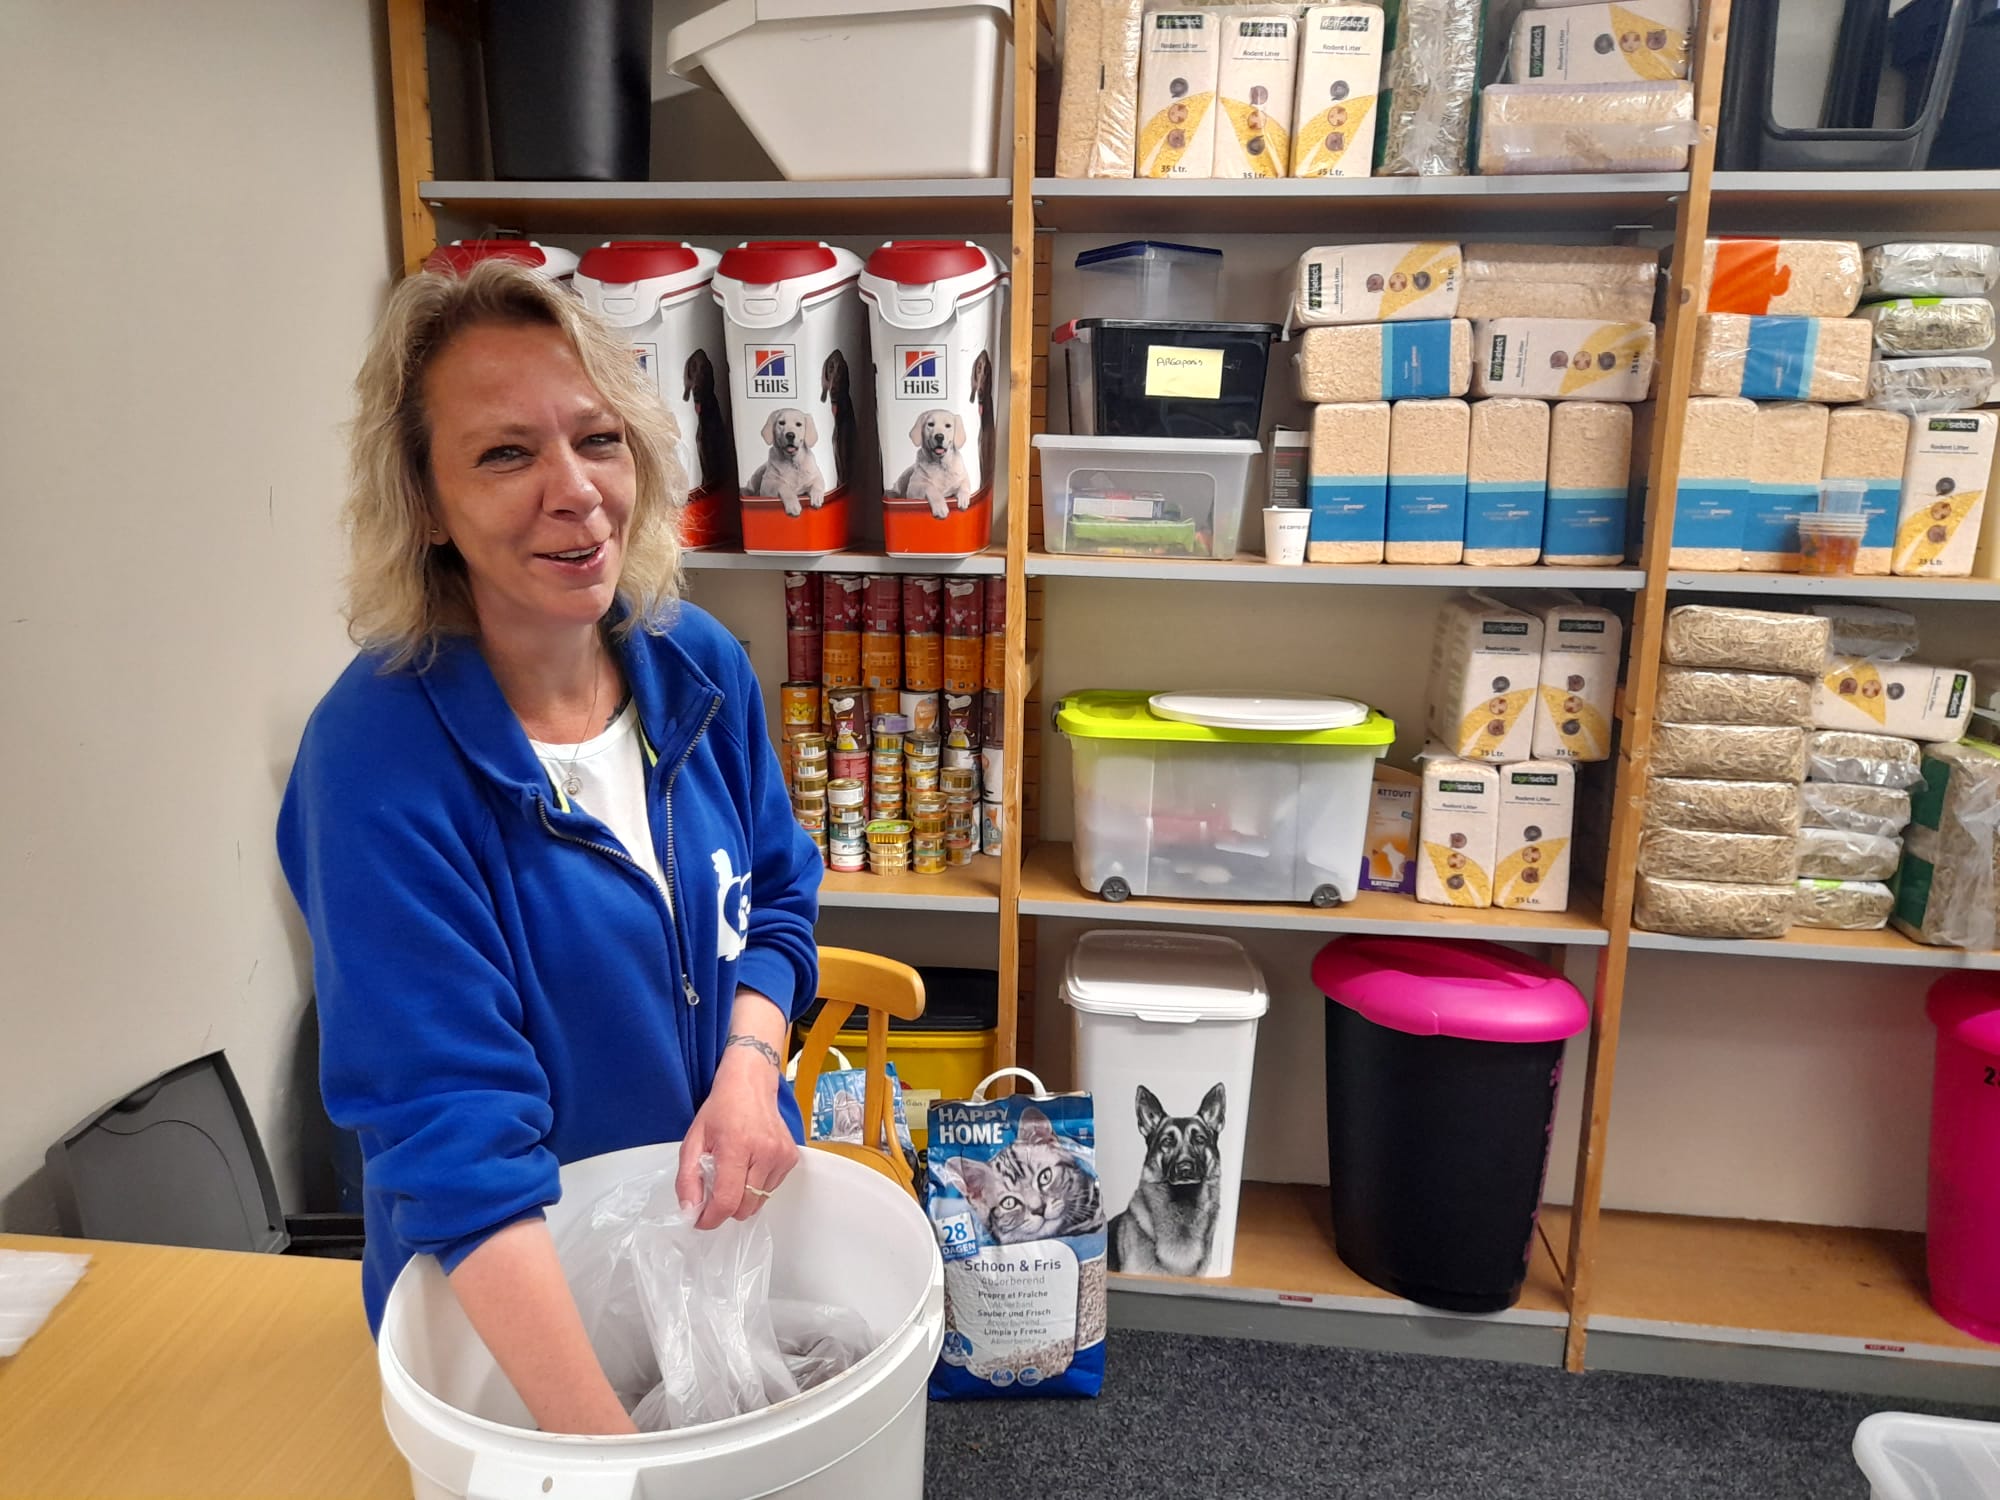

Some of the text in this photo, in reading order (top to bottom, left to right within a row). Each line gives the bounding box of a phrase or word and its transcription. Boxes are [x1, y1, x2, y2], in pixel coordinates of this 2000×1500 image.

[1161, 165, 1171, 173] 35
[754, 380, 789, 394] Hill's
[903, 380, 939, 395] Hill's
[1930, 420, 1977, 432] agriselect
[1513, 774, 1556, 785] agriselect
[1440, 782, 1483, 793] agriselect
[1984, 1065, 2000, 1088] 2
[938, 1107, 1009, 1122] HAPPY
[939, 1123, 1004, 1145] HOME
[942, 1222, 968, 1244] 28
[942, 1242, 977, 1255] DAGEN
[964, 1259, 1061, 1272] Schoon & Fris
[977, 1308, 1051, 1318] Sauber und Frisch
[984, 1328, 1012, 1337] Limpia
[1020, 1327, 1047, 1336] Fresca
